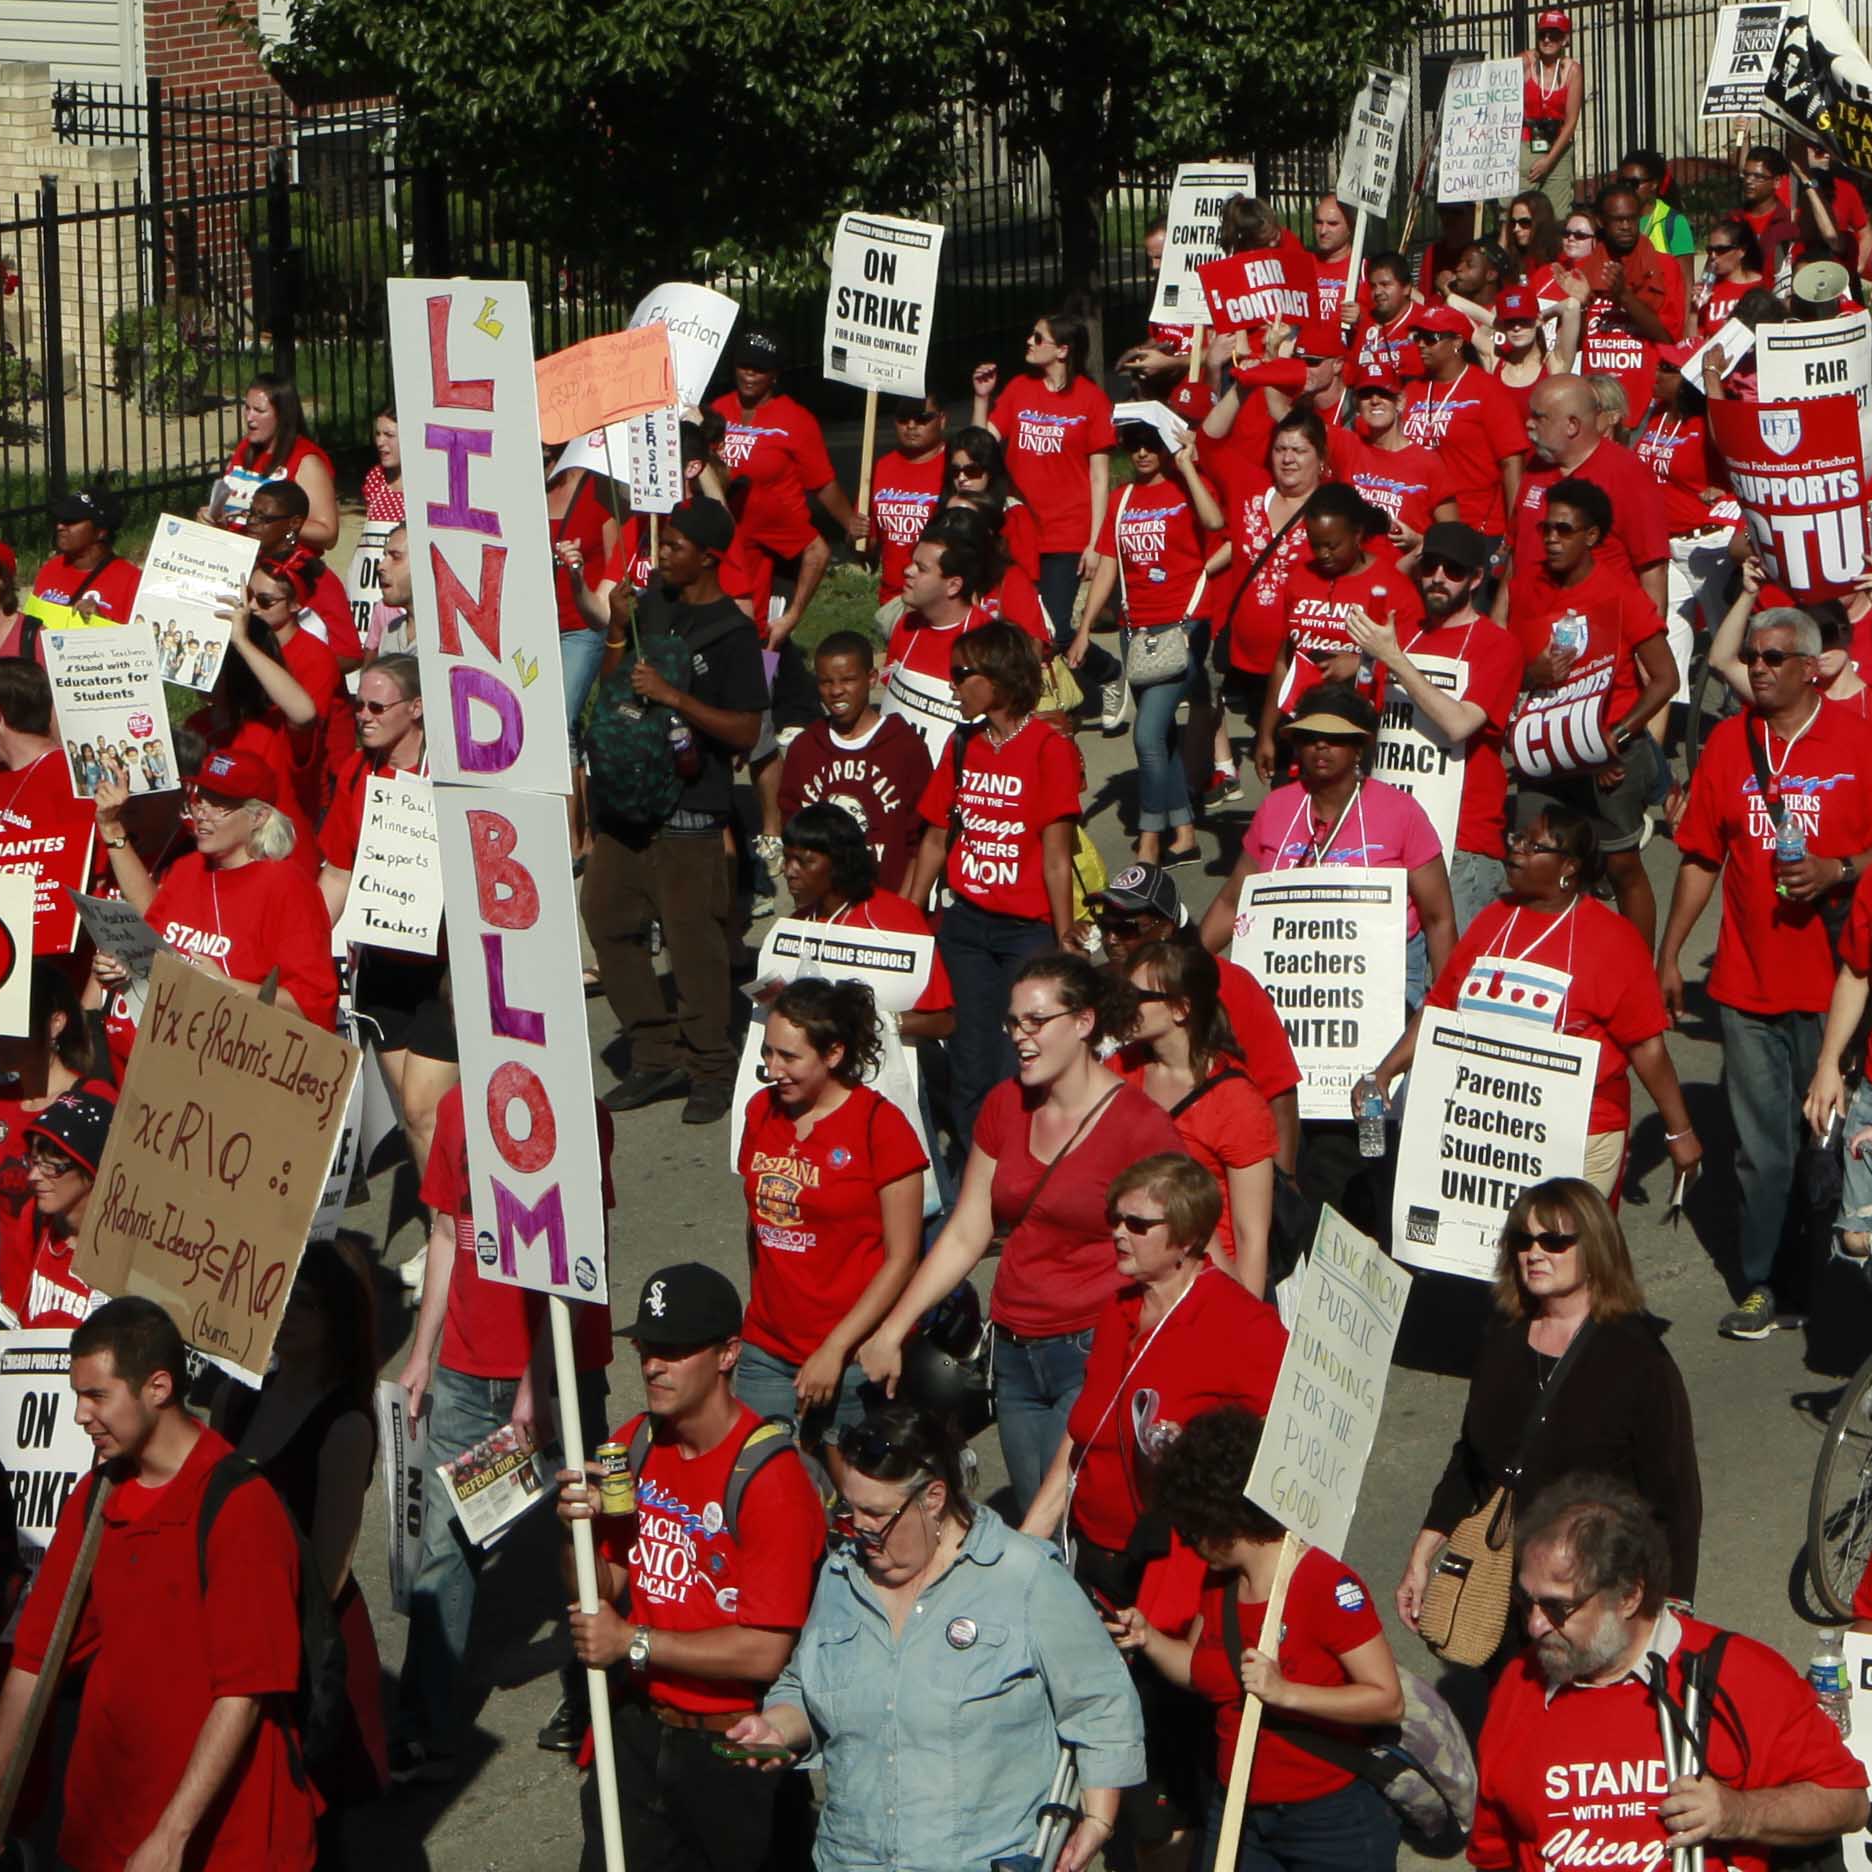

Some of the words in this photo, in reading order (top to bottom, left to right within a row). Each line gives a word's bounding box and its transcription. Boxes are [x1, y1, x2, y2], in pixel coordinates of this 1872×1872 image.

[1453, 89, 1519, 109] SILENCES
[1373, 153, 1390, 169] are
[1193, 197, 1223, 218] FAIR
[864, 248, 897, 285] ON
[1244, 258, 1286, 288] FAIR
[836, 289, 922, 334] STRIKE
[1226, 289, 1310, 322] CONTRACT
[835, 327, 849, 342] FOR
[855, 330, 872, 347] FAIR
[874, 336, 918, 356] CONTRACT
[1804, 358, 1849, 387] FAIR
[1018, 435, 1062, 454] UNION
[1019, 422, 1065, 438] TEACHERS
[1750, 460, 1800, 473] Federation
[1815, 454, 1856, 469] Teachers
[1731, 469, 1859, 505] SUPPORTS
[877, 503, 929, 519] TEACHERS
[1749, 509, 1866, 590] CTU
[56, 674, 122, 688] Educators
[128, 673, 149, 682] for
[74, 663, 103, 672] Stand
[106, 661, 130, 669] with
[74, 689, 135, 702] Students
[1513, 695, 1609, 778] CTU
[424, 294, 569, 1285] LINDBLOM
[961, 769, 1023, 797] STAND
[371, 813, 438, 843] Minnesota
[363, 845, 430, 870] Supports
[359, 876, 416, 905] Chicago
[362, 908, 429, 938] Teachers
[1272, 916, 1358, 942] Parents
[163, 921, 231, 958] STAND
[856, 950, 912, 971] SCHOOLS
[1263, 950, 1366, 976] Teachers
[1265, 984, 1364, 1010] Students
[1456, 1065, 1543, 1108] Parents
[1444, 1097, 1547, 1144] Teachers
[750, 1151, 820, 1187] ESPAÑA
[1441, 1132, 1543, 1179] Students
[1441, 1169, 1528, 1213] UNITE
[1318, 1275, 1377, 1357] PUBLIC
[1291, 1314, 1375, 1416] FUNDING
[16, 1391, 59, 1449] ON
[1292, 1372, 1328, 1420] FOR
[1327, 1399, 1356, 1449] THE
[1284, 1417, 1346, 1500] PUBLIC
[457, 1470, 494, 1498] DEFEND
[495, 1458, 515, 1477] OUR
[1270, 1467, 1322, 1528] GOOD
[1573, 1803, 1613, 1821] WITH
[1617, 1802, 1646, 1818] THE
